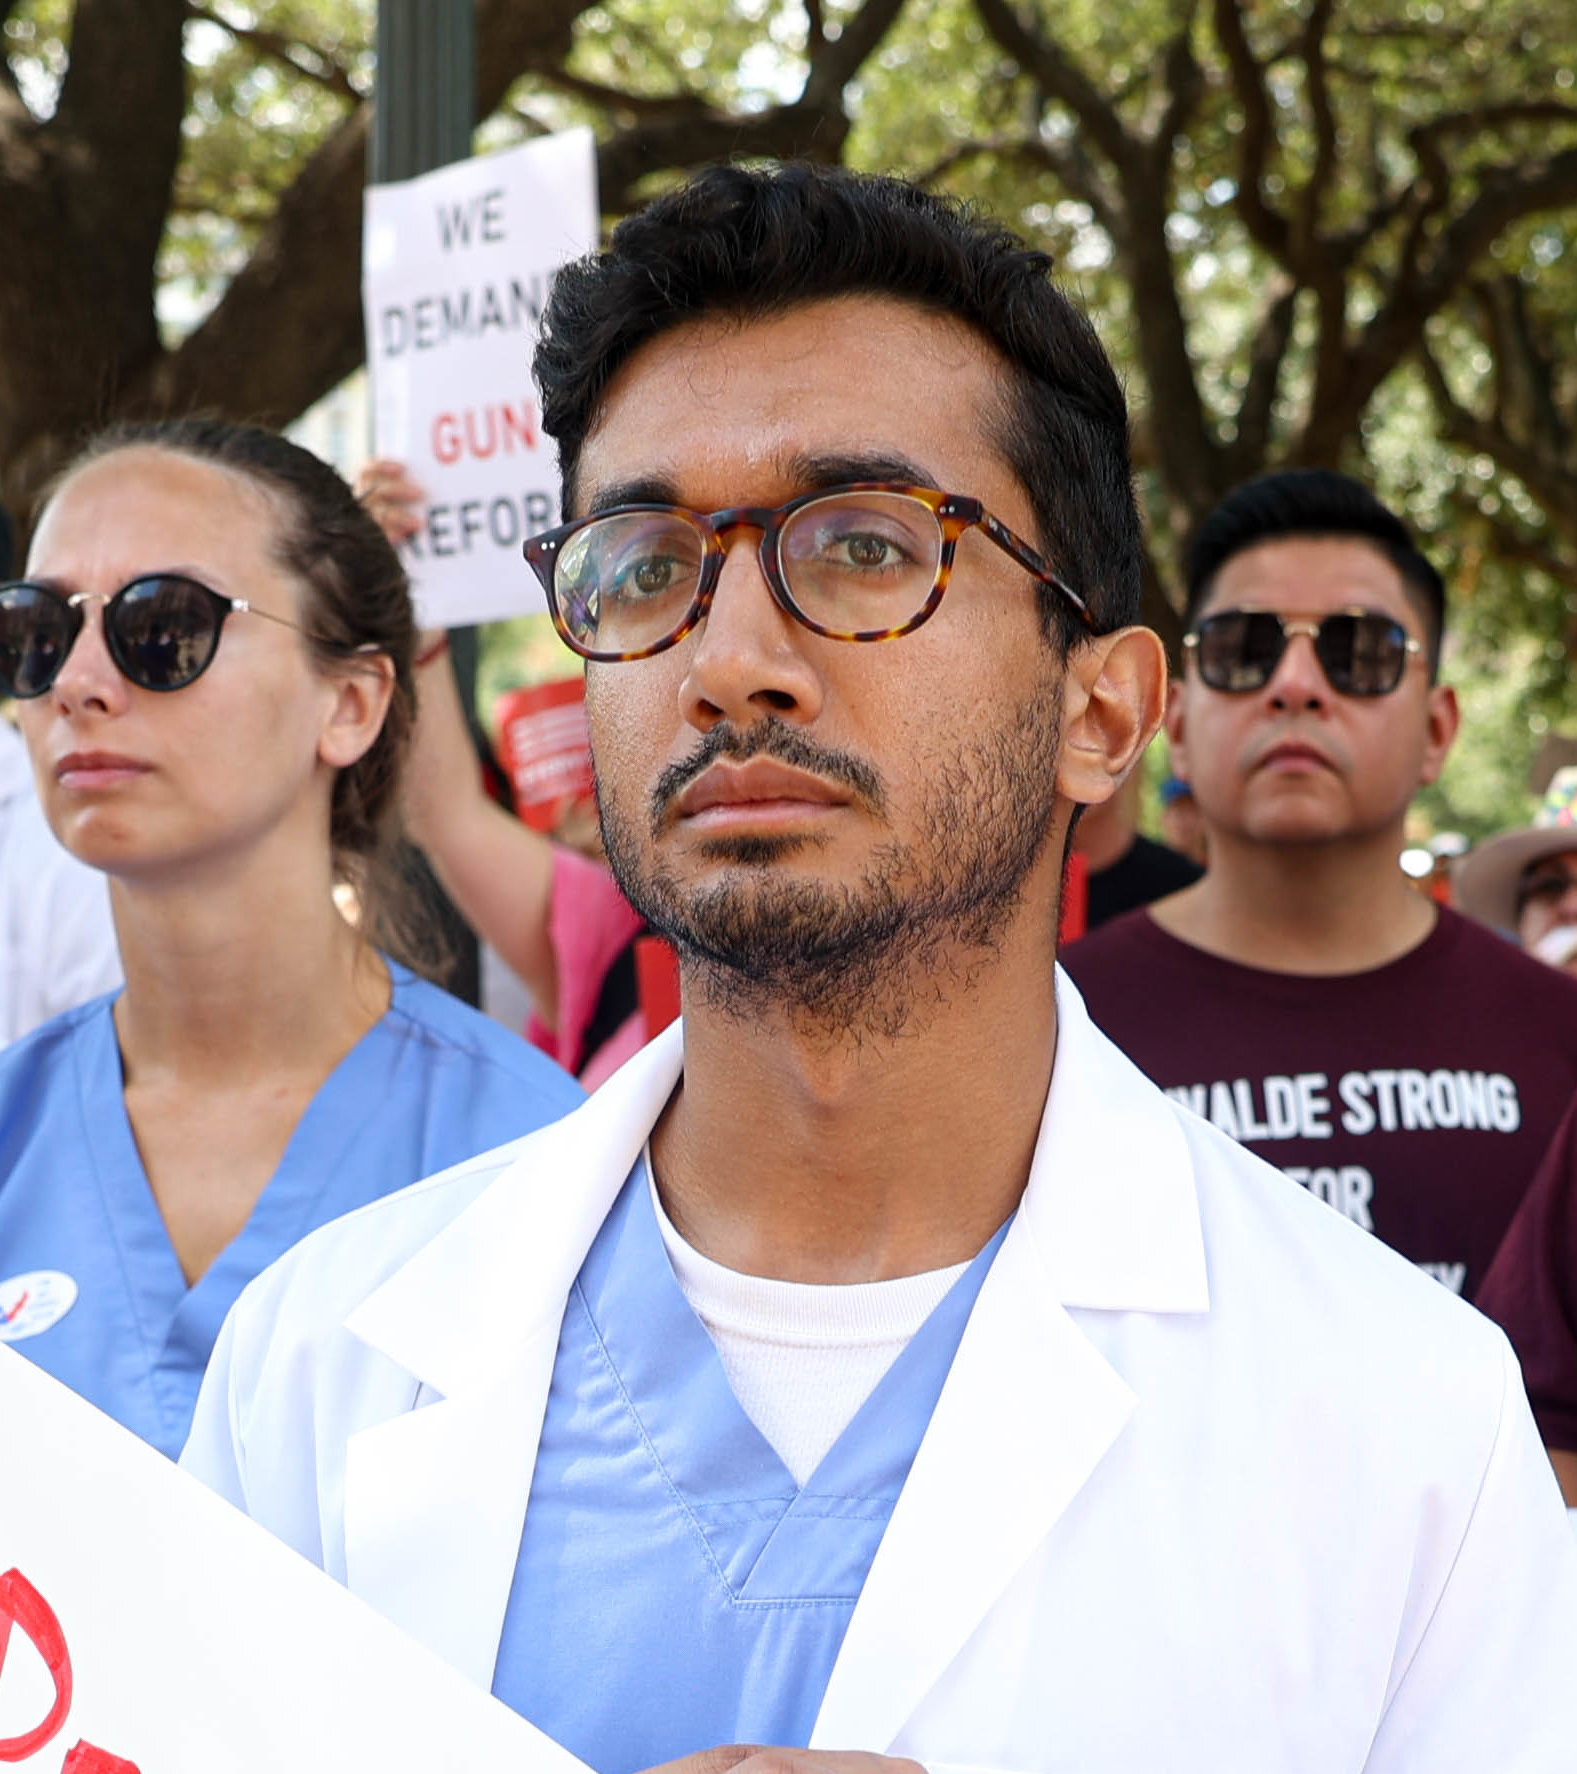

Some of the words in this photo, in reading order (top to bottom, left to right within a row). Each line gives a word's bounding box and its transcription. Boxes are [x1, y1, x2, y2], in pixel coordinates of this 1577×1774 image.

[435, 190, 506, 250] WE
[383, 267, 557, 358] DEMAN
[432, 401, 537, 465] GUN
[1164, 1073, 1333, 1141] VALDE
[1338, 1070, 1521, 1132] STRONG
